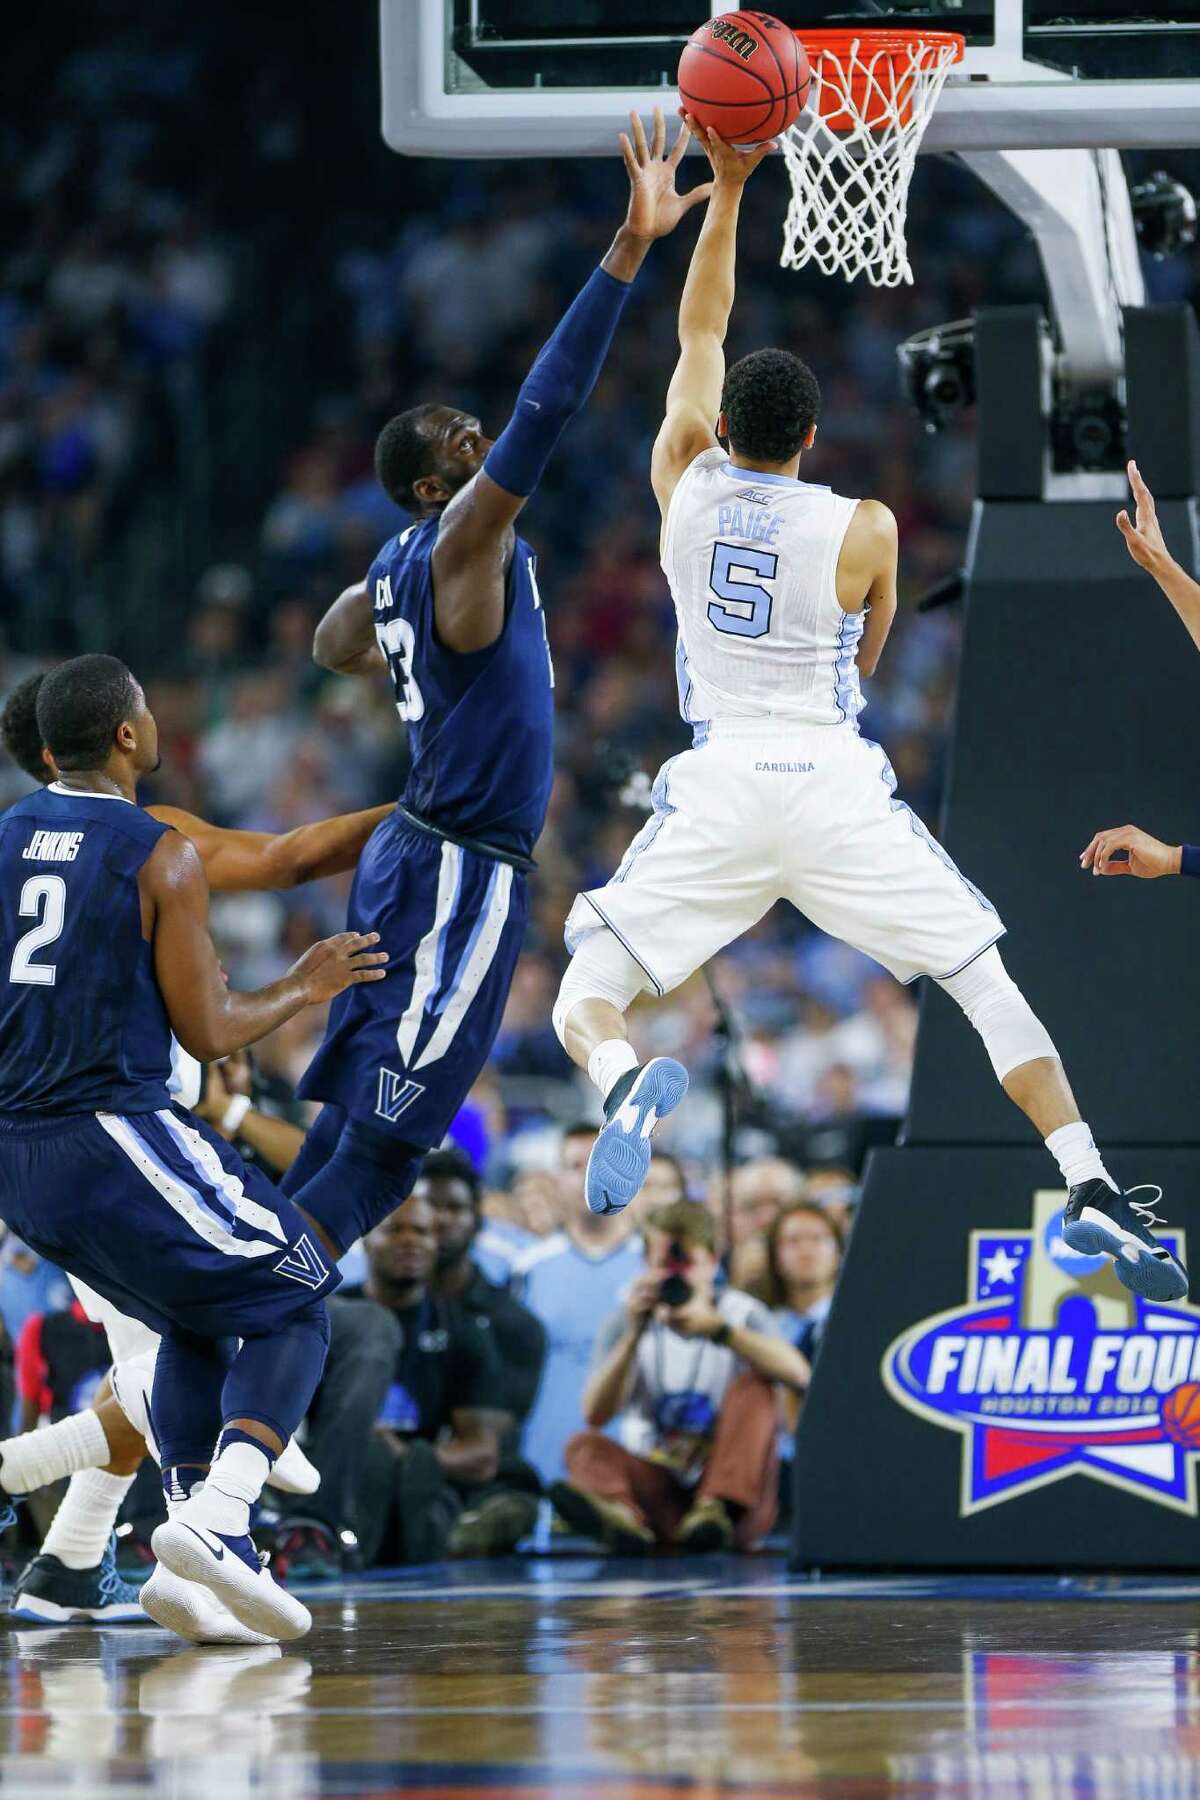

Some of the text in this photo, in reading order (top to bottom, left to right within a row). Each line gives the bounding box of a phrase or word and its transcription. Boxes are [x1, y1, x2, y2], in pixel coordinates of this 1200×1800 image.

[718, 504, 786, 545] PAIGE
[707, 541, 779, 639] 5
[755, 761, 816, 773] CAROLINA
[22, 830, 85, 862] JENKINS
[9, 874, 67, 986] 2
[925, 1335, 1077, 1394] FINAL
[980, 1396, 1092, 1415] HOUSTON
